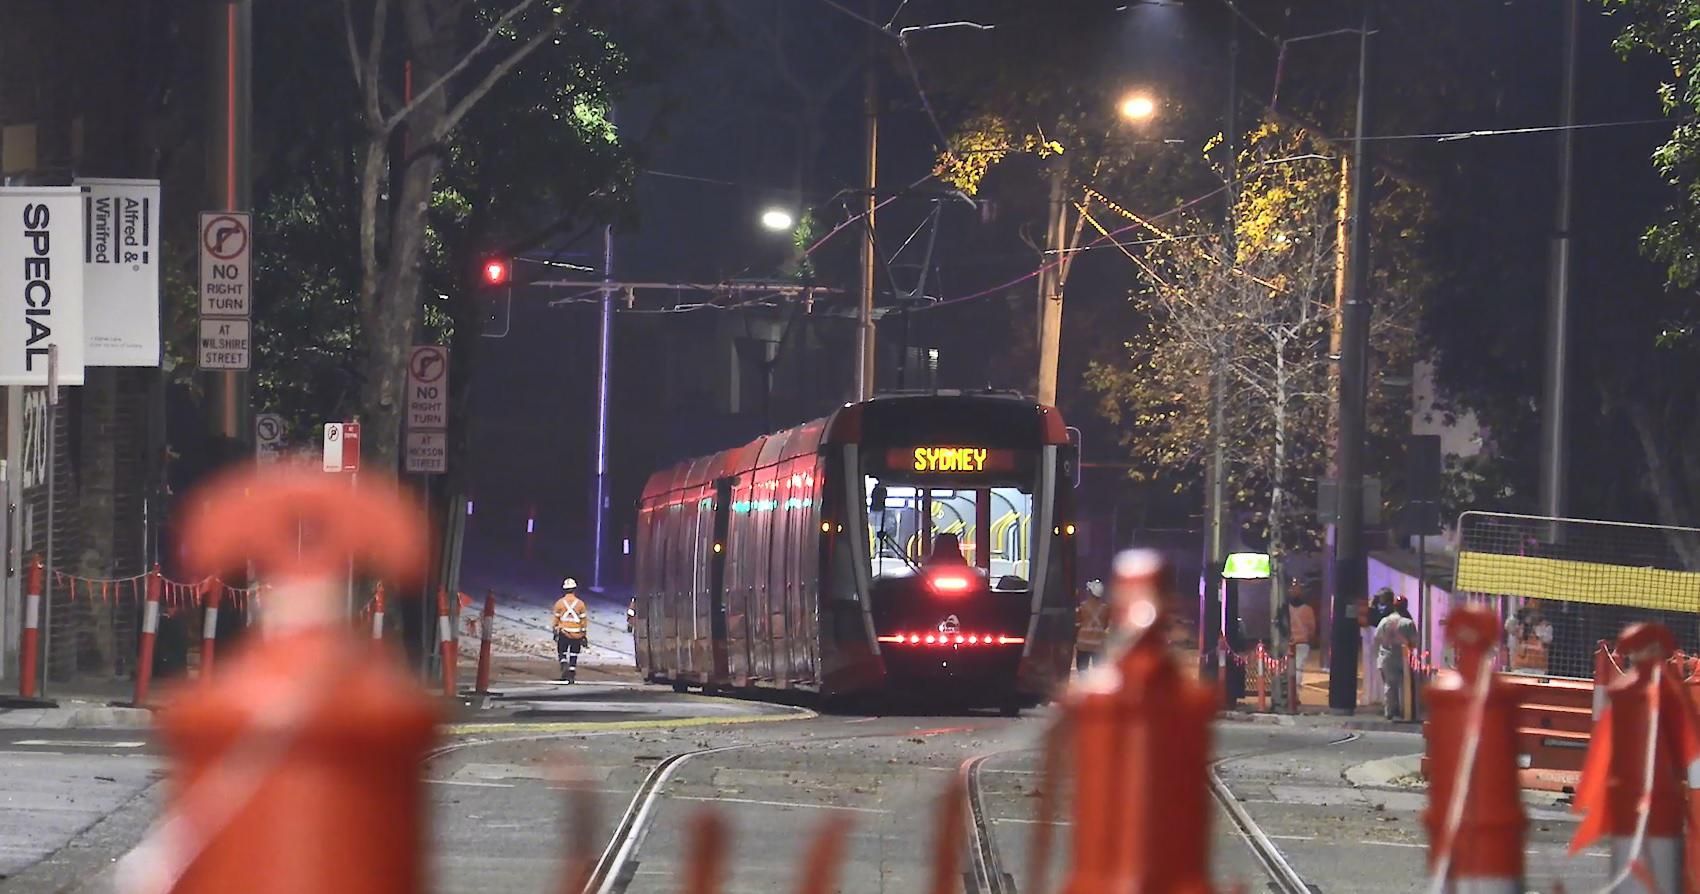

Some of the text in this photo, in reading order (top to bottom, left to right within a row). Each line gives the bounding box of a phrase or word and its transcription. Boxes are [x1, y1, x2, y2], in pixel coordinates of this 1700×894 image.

[95, 197, 110, 264] Winifred
[124, 197, 139, 263] Alfred &
[212, 264, 239, 280] NO
[23, 203, 51, 371] SPECIAL
[206, 283, 243, 295] RIGHT
[208, 298, 243, 310] TURN
[218, 324, 231, 336] AT
[202, 339, 247, 350] WILSHIRE
[205, 352, 243, 364] STREET
[416, 386, 438, 400] NO
[411, 402, 442, 412] RIGHT
[414, 413, 441, 424] TURN
[421, 436, 432, 445] AT
[914, 447, 987, 471] SYDNEY
